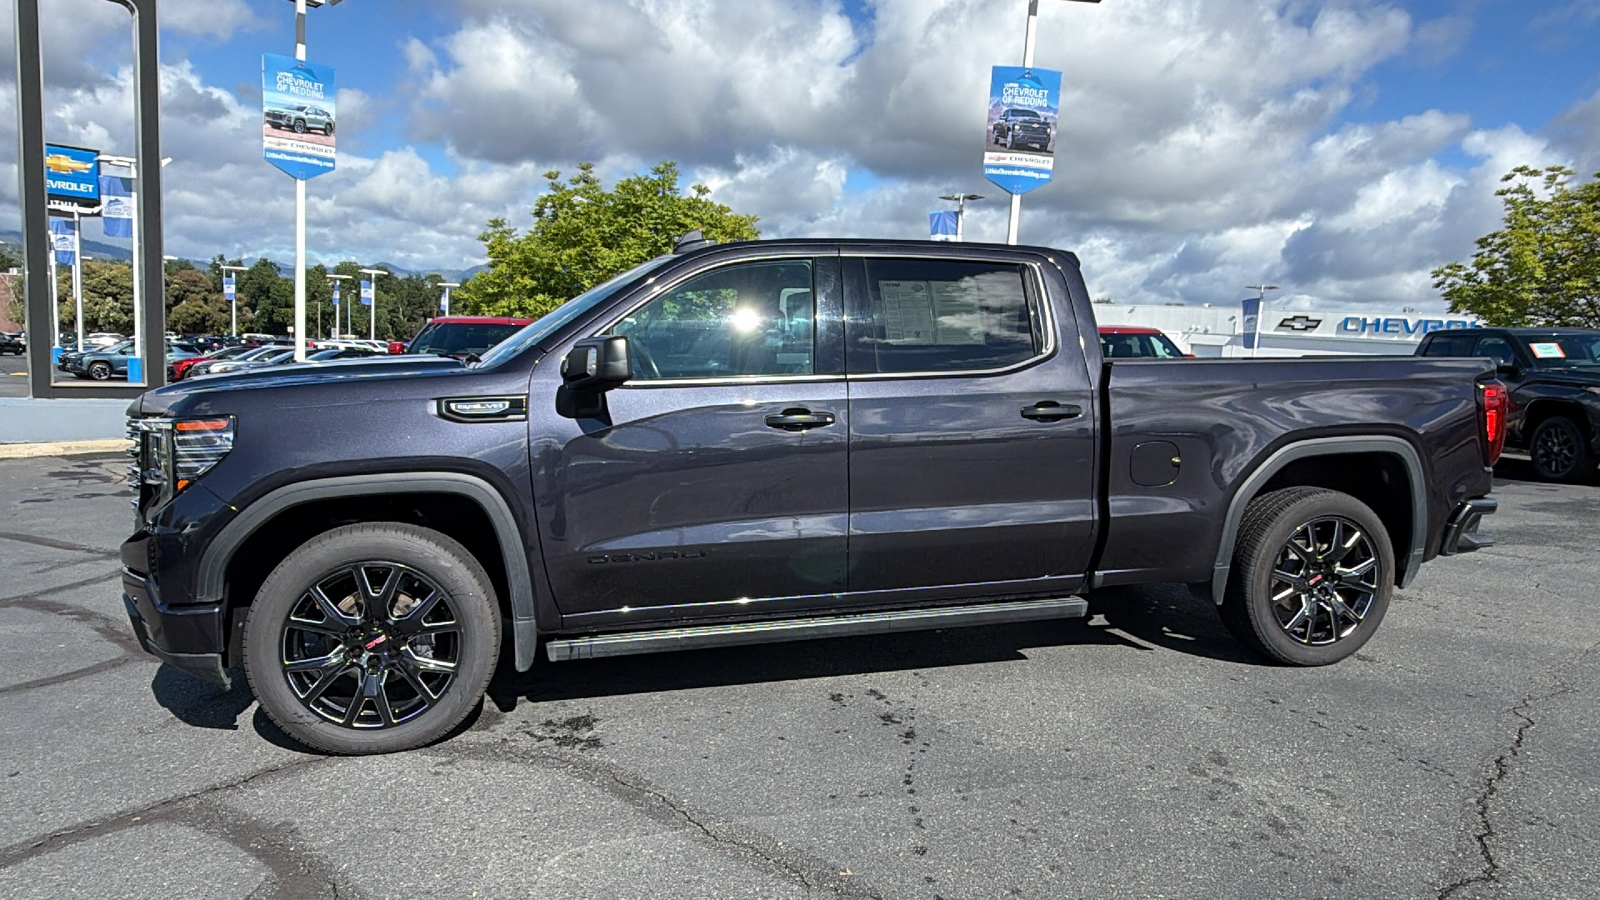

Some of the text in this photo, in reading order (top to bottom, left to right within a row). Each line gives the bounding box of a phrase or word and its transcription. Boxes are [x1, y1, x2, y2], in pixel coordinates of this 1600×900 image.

[277, 75, 324, 90] CHEVROLET
[277, 84, 324, 98] OF REDDING
[1003, 88, 1048, 98] CHEVROLET
[1002, 96, 1047, 107] OF REDDING
[291, 142, 332, 154] CHEVROLET
[1010, 156, 1050, 164] CHEVROLET
[46, 179, 94, 193] EVROLET
[1342, 316, 1478, 335] CHEVRO
[587, 550, 706, 564] DENALI
